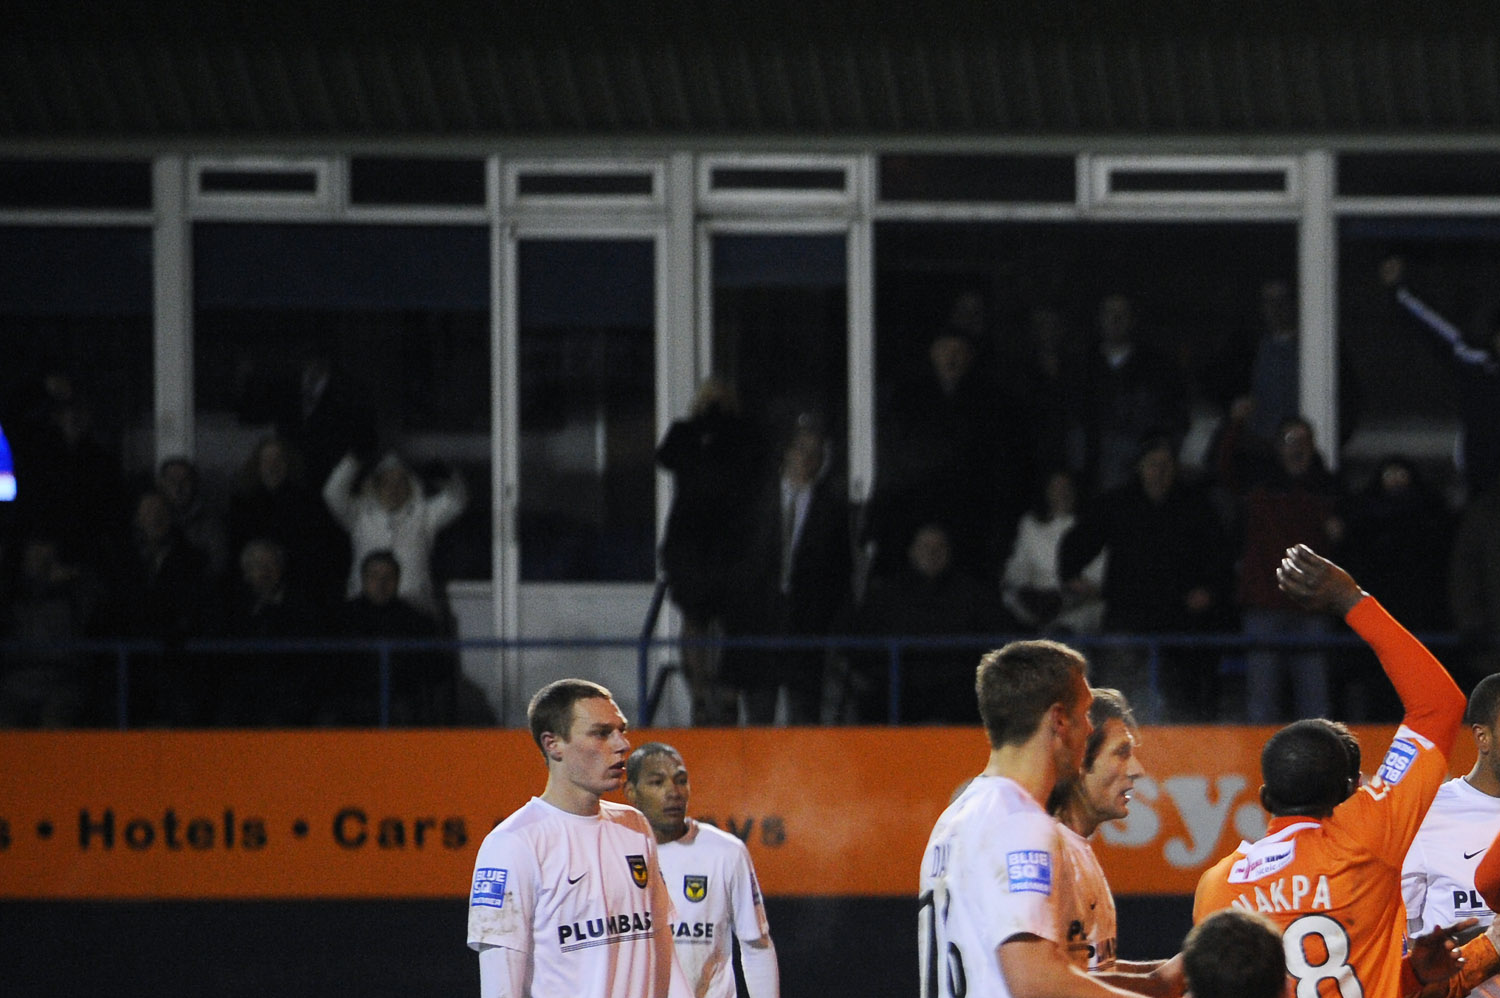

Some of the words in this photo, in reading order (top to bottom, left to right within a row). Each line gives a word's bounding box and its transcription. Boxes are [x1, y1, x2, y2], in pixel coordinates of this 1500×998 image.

[78, 807, 269, 851] Hotels
[332, 807, 469, 850] Cars
[1008, 852, 1049, 866] BLUE
[1009, 864, 1039, 880] SQ
[670, 922, 714, 938] ASE
